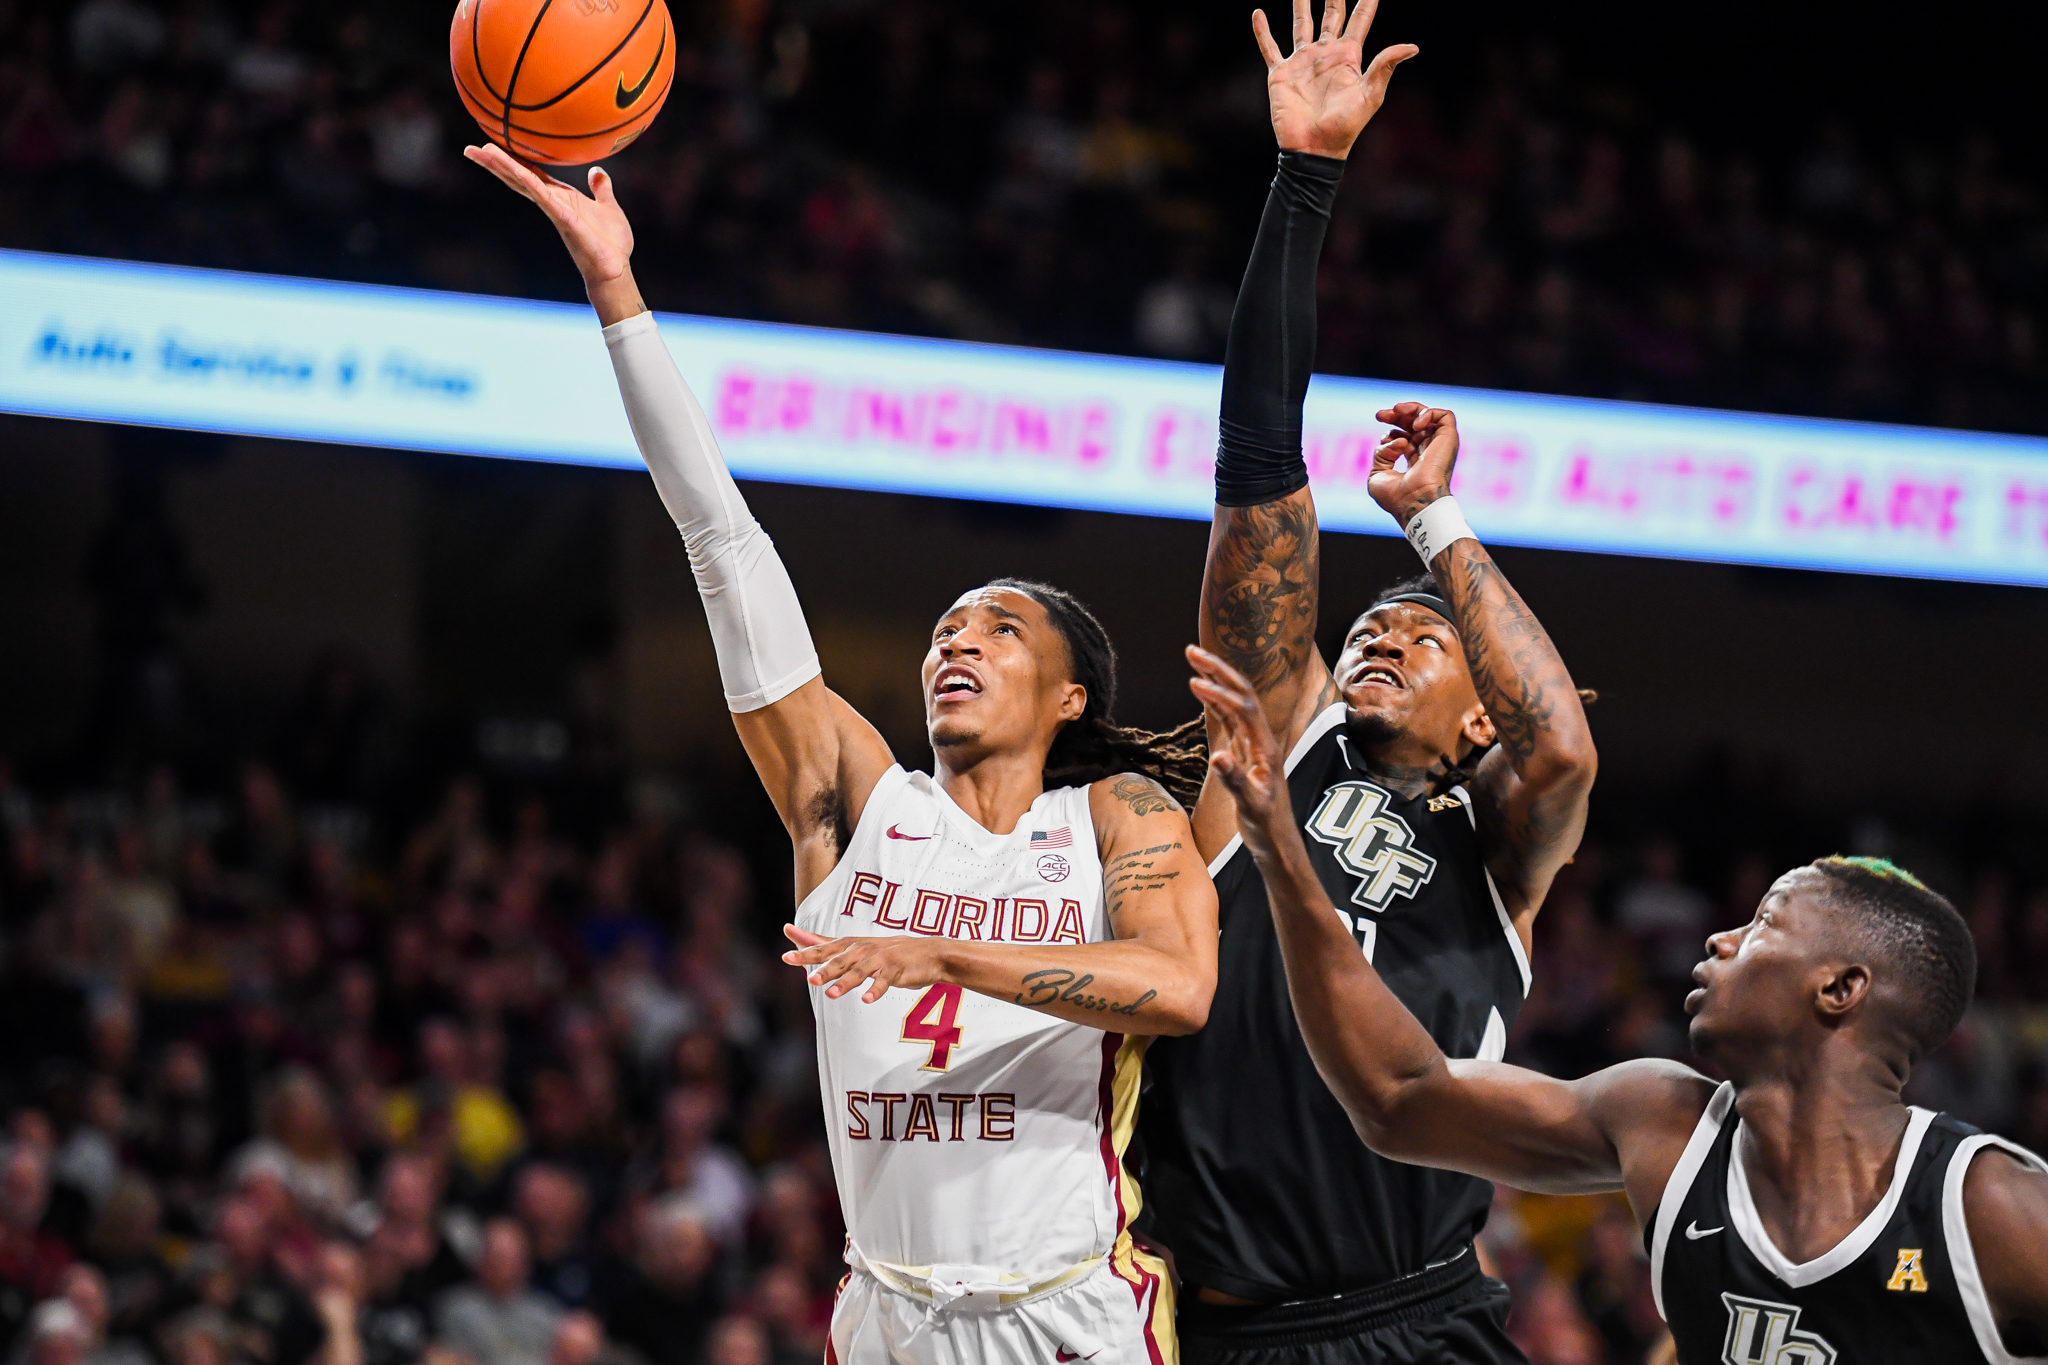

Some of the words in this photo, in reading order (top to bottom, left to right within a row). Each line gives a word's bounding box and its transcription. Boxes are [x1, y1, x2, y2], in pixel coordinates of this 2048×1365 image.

[715, 368, 1114, 465] BRINGING
[1560, 453, 1757, 529] AUTO
[1783, 464, 1962, 542] CARE
[1041, 862, 1067, 870] ACC
[1305, 780, 1437, 912] UCF
[840, 871, 1087, 945] FLORIDA
[900, 982, 965, 1073] 4
[1015, 968, 1158, 1017] Blessed
[846, 1090, 1016, 1142] STATE
